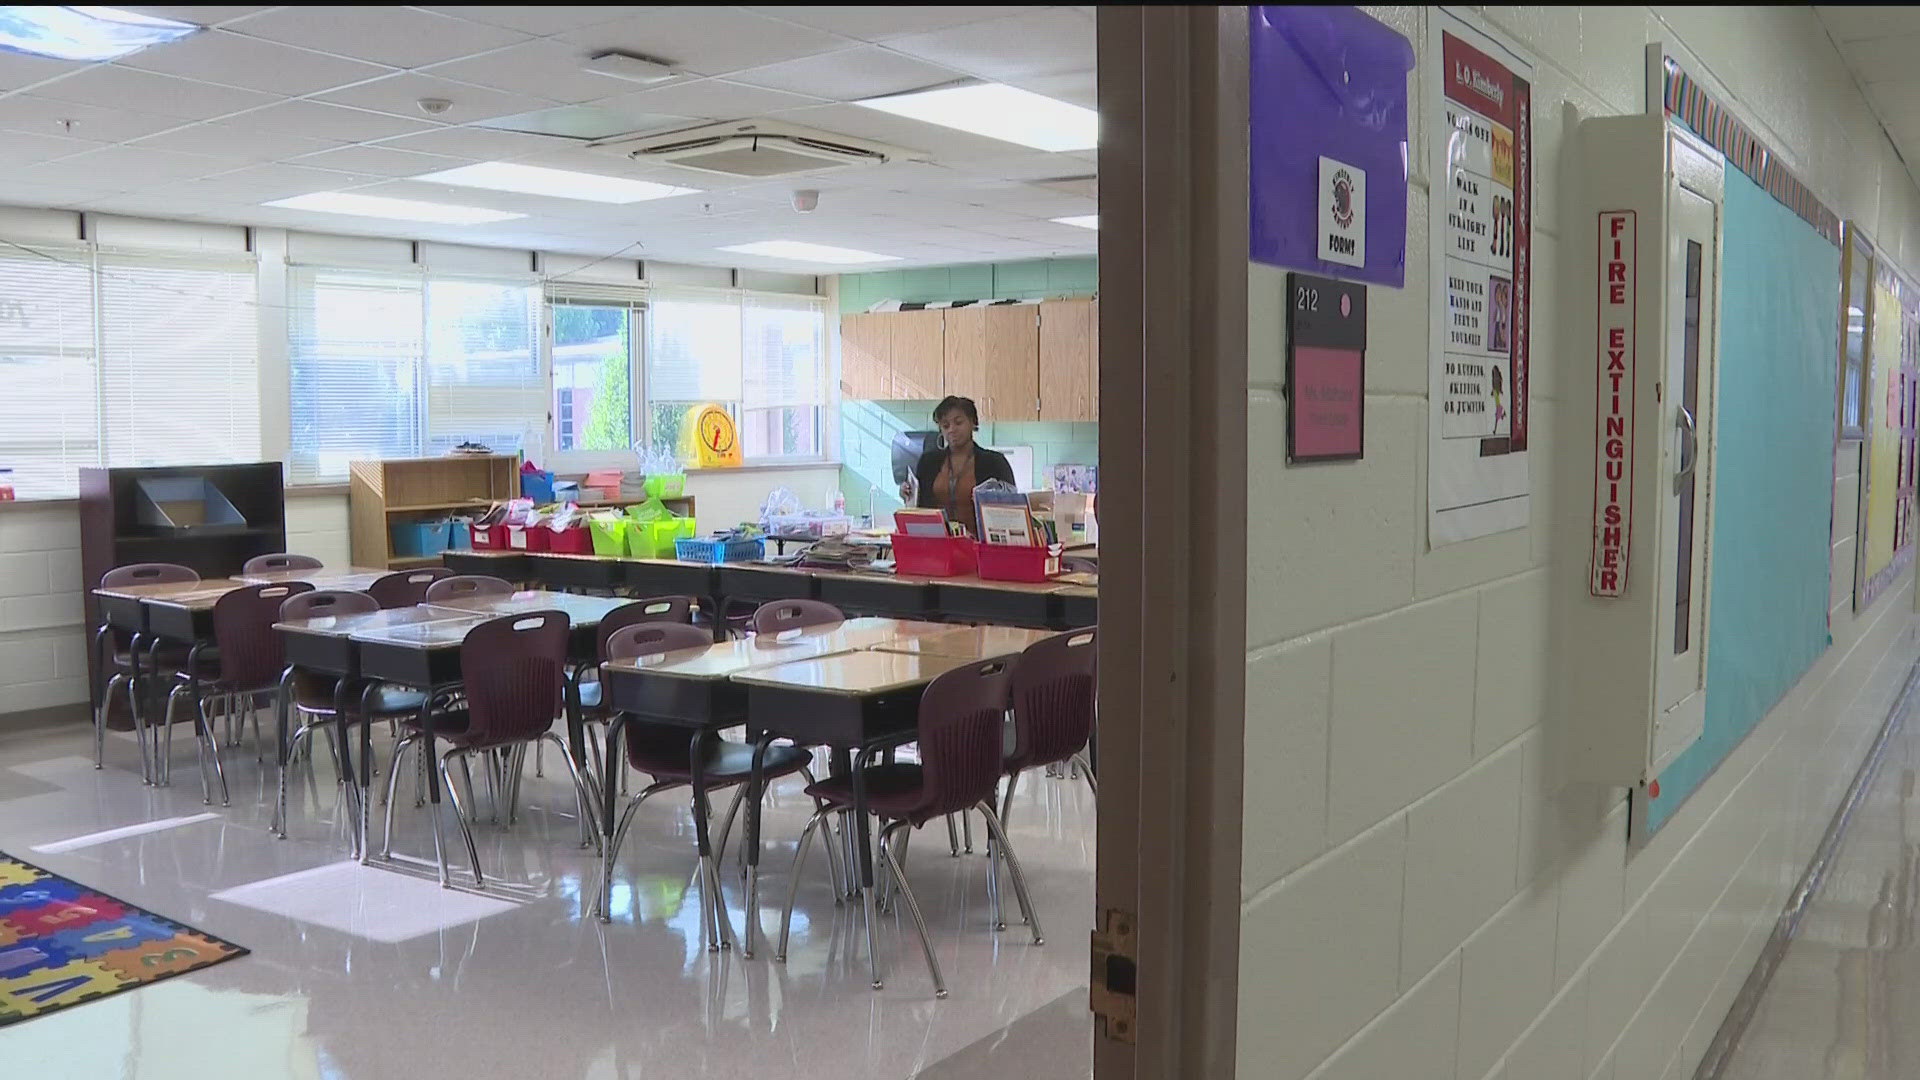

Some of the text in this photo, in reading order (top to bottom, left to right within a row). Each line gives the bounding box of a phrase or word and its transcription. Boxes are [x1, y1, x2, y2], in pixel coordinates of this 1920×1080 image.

[1456, 176, 1478, 195] WALK
[1448, 213, 1486, 236] STRAIGHT
[1458, 236, 1475, 252] LINE
[1297, 287, 1318, 312] 212
[1446, 363, 1455, 375] NO
[1444, 401, 1454, 414] OR
[1600, 217, 1626, 590] FIRE EXTINGUISHER
